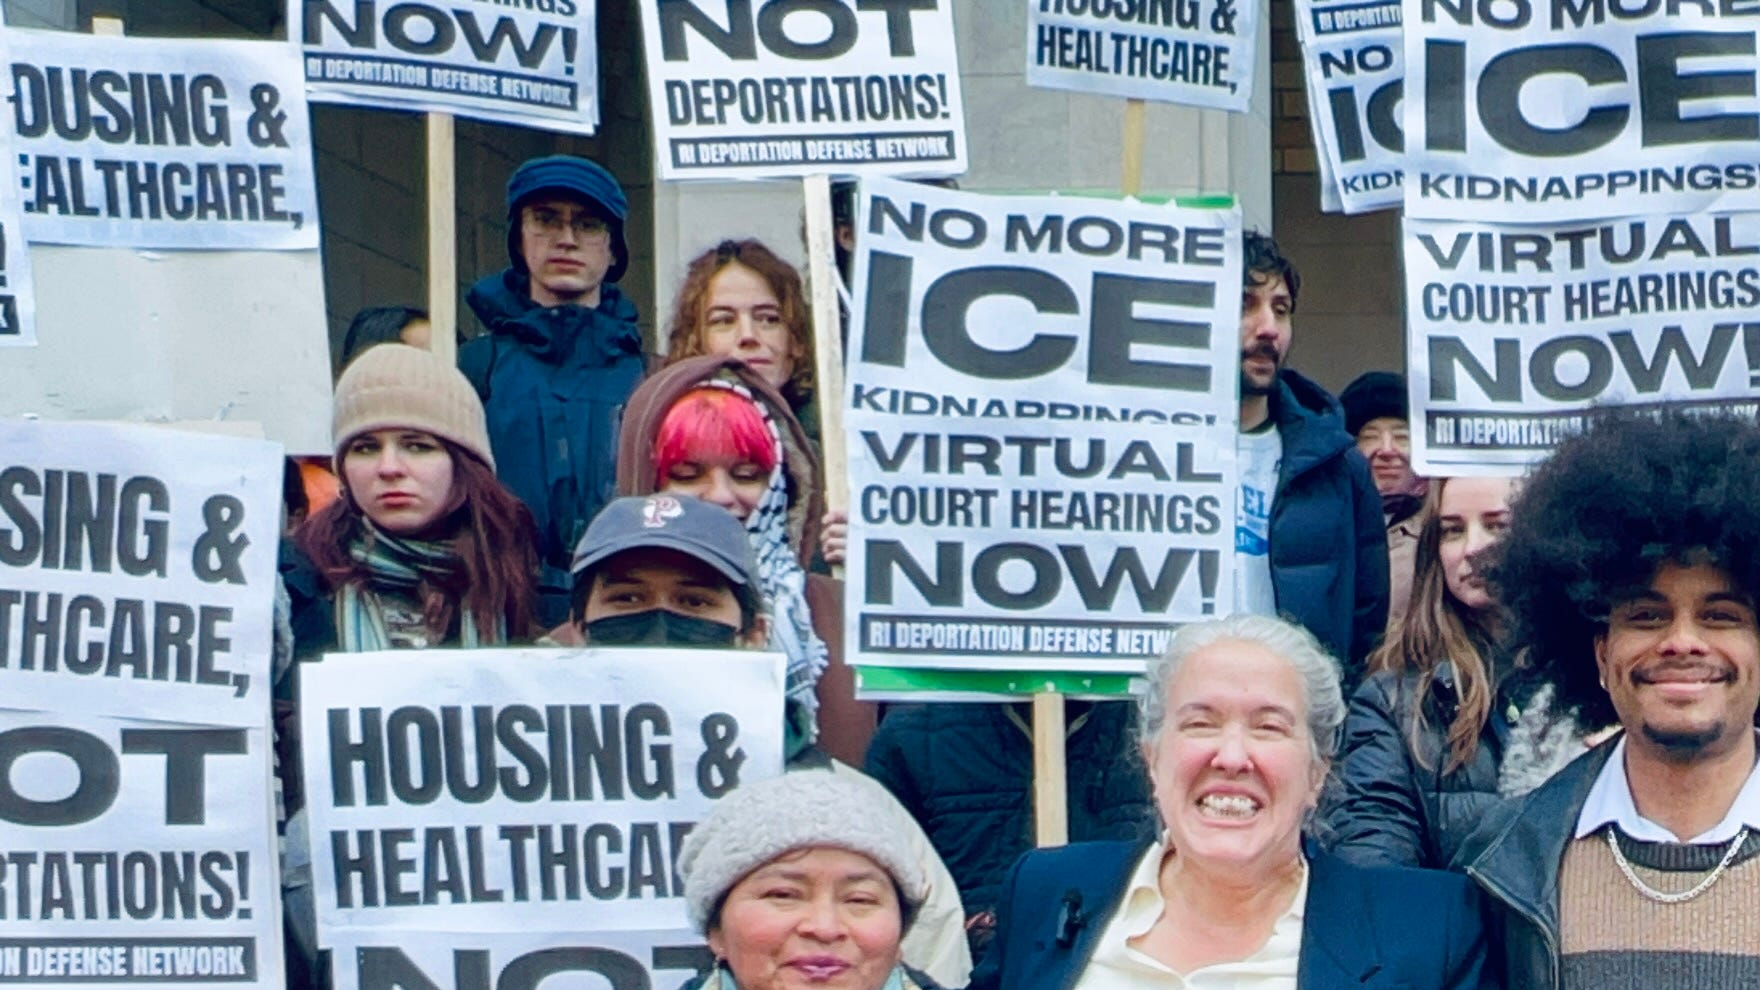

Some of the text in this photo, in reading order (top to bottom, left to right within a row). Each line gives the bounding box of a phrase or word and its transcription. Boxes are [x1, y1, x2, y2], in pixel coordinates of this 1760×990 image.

[303, 0, 577, 75] NOW!
[656, 0, 938, 61] NOT
[325, 58, 427, 87] DEPORTATION
[431, 69, 498, 95] DEFENSE
[501, 78, 572, 107] NETWORK
[1036, 24, 1238, 95] HEALTHCARE,
[1319, 45, 1393, 79] NO
[8, 62, 290, 148] OUSING &
[664, 73, 951, 126] DEPORTATIONS!
[678, 136, 949, 164] RI DEPORTATION DEFENSE NETWORK
[868, 195, 1225, 267] NO MORE
[860, 249, 1217, 393] ICE
[1423, 280, 1552, 325] COURT
[860, 430, 1223, 483] VIRTUAL
[860, 484, 1221, 535] COURT HEARINGS
[192, 494, 251, 586] &
[864, 538, 1221, 615] NOW!
[869, 622, 891, 647] RI
[898, 622, 1025, 652] DEPORTATION
[1029, 626, 1113, 653] DEFENSE
[326, 702, 747, 808] HOUSING &
[27, 945, 128, 977] DEFENSE
[132, 945, 246, 977] NETWORK
